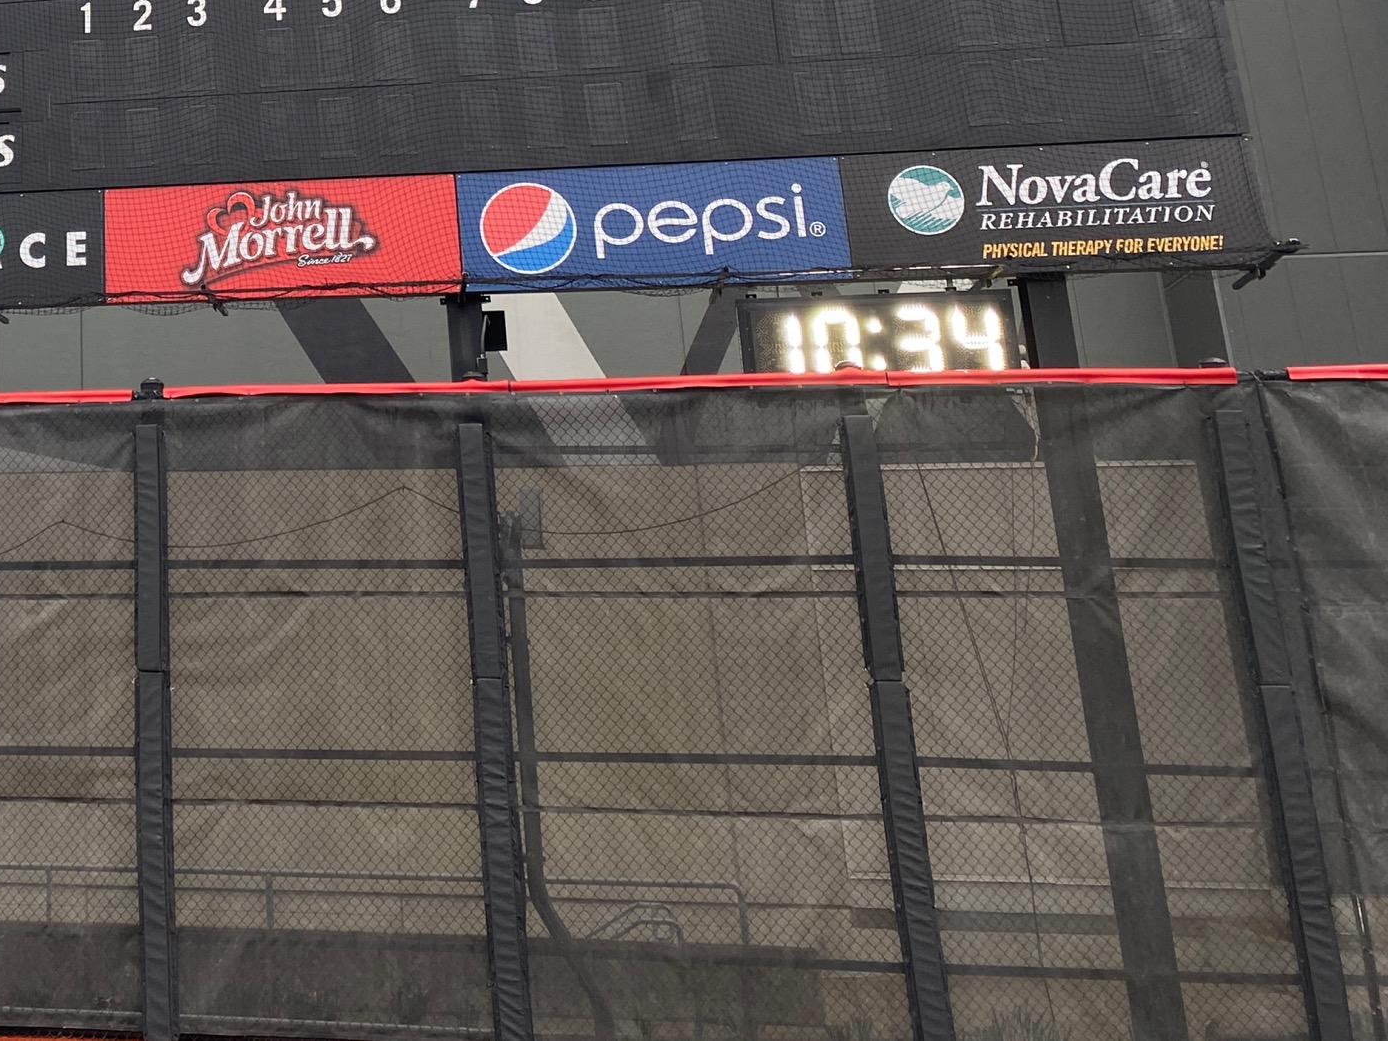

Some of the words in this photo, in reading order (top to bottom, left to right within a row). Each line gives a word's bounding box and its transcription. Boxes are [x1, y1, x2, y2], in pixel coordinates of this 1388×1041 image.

[80, 2, 92, 34] 1
[132, 0, 153, 31] 2
[976, 158, 1212, 207] NovaCare
[250, 191, 322, 227] John
[980, 205, 1216, 230] REHABILITATION
[183, 208, 376, 284] Morrell
[297, 254, 331, 267] Since
[983, 242, 1048, 259] PHYSICAL
[1051, 239, 1113, 257] THERAPY
[1115, 238, 1144, 254] FOR
[1147, 235, 1224, 253] EVERYONE!
